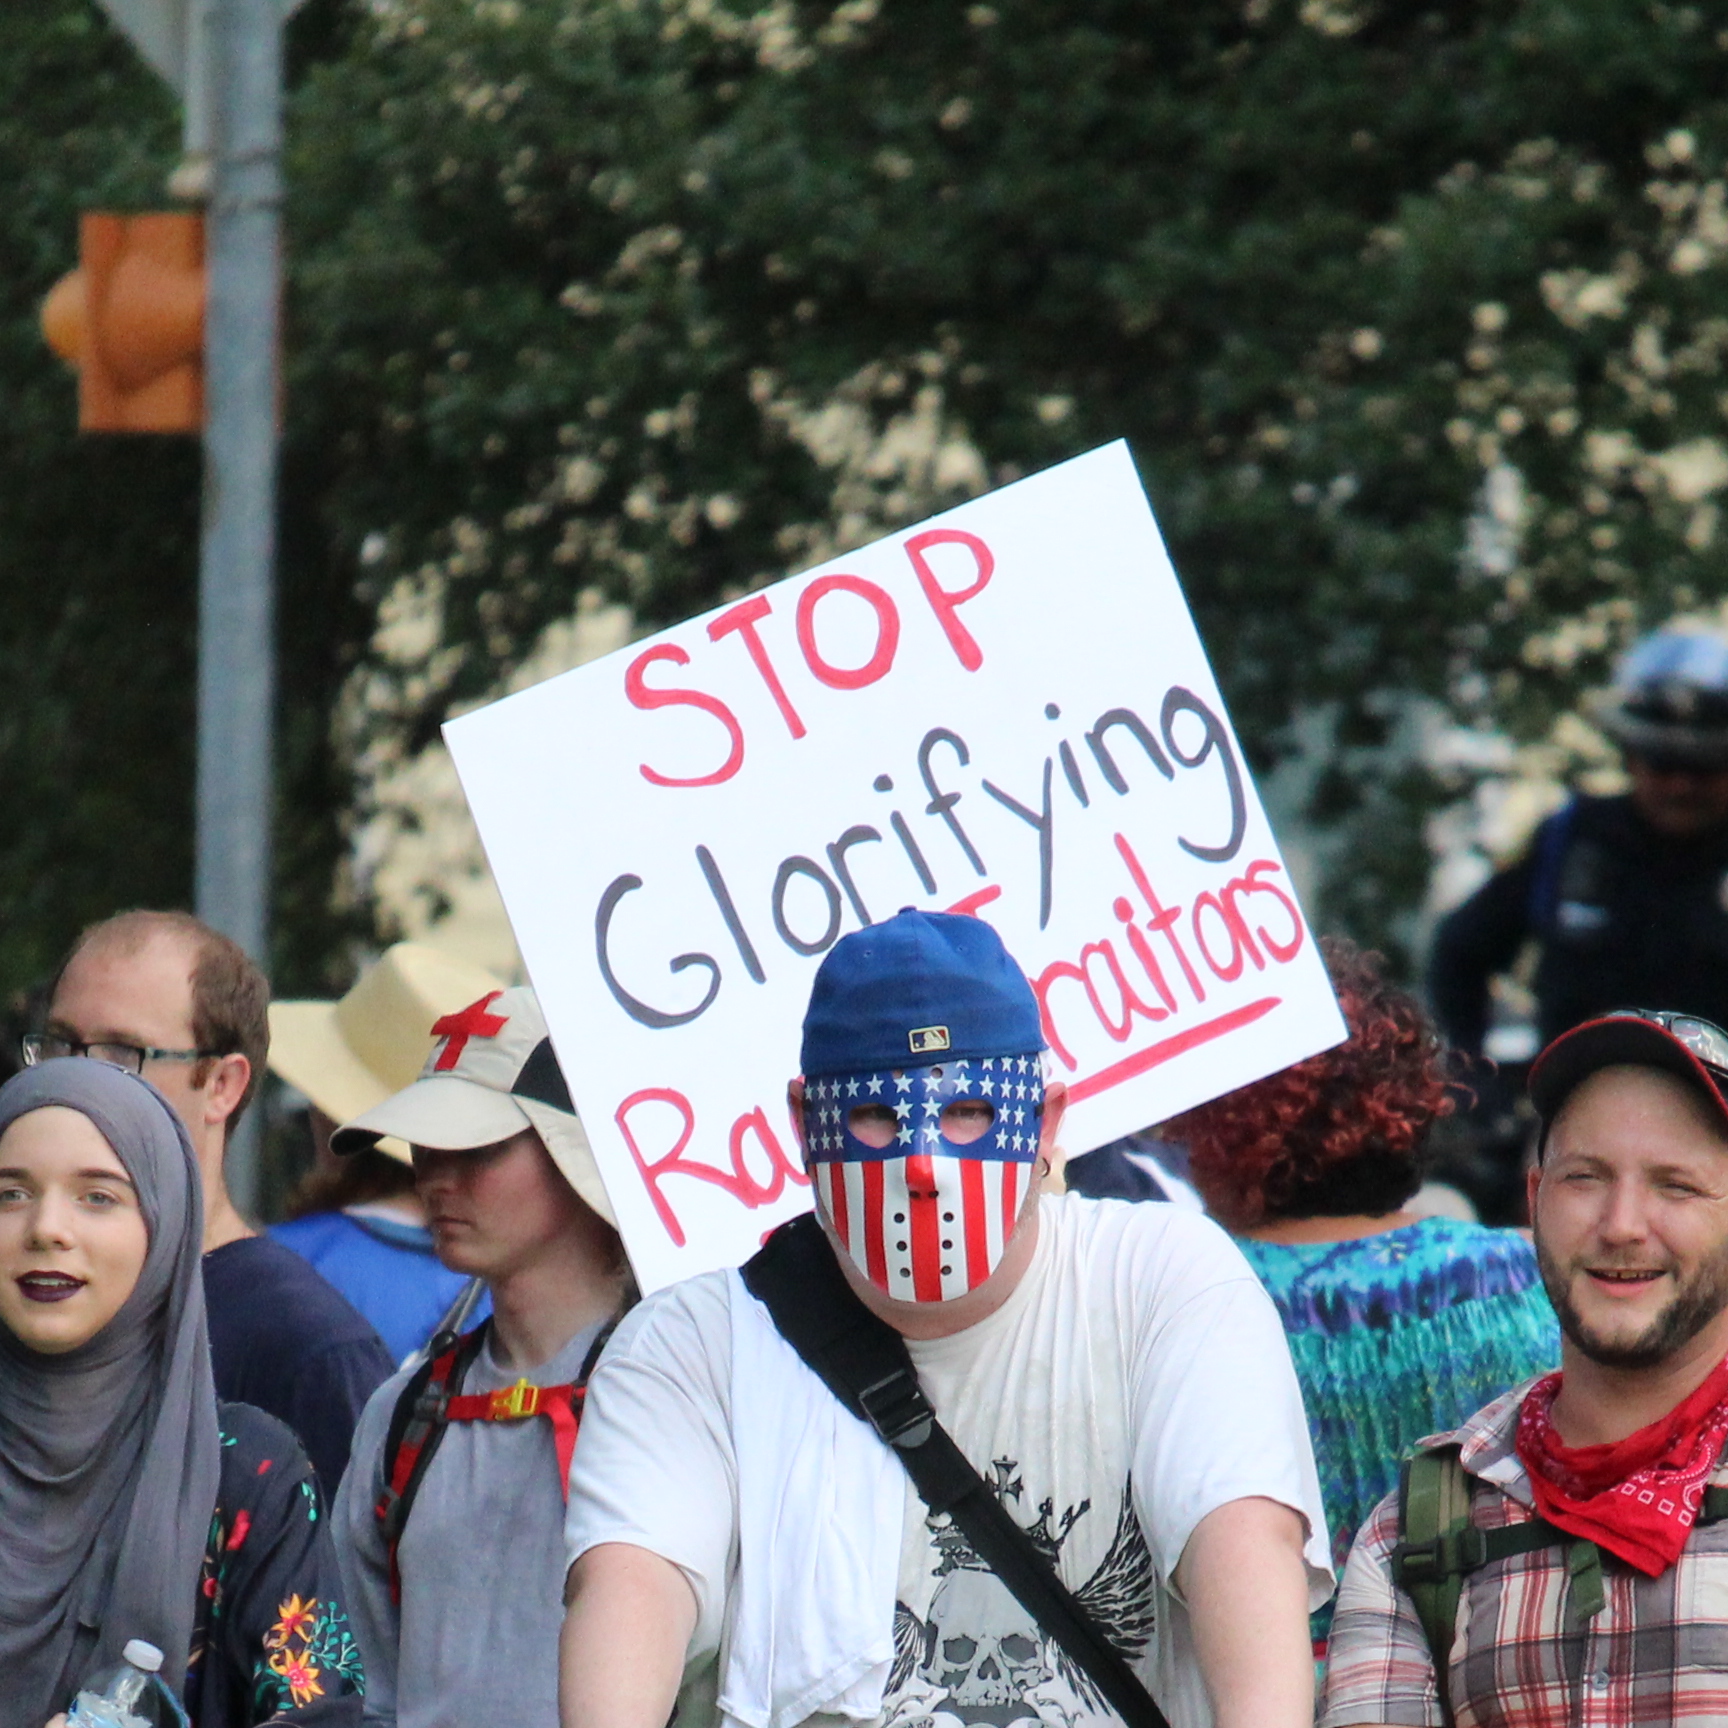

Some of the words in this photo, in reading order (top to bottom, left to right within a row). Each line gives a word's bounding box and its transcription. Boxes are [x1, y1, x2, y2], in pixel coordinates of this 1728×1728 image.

[624, 528, 995, 787] STOP
[594, 684, 1249, 1030] Glorifying
[944, 831, 1305, 1073] raitors
